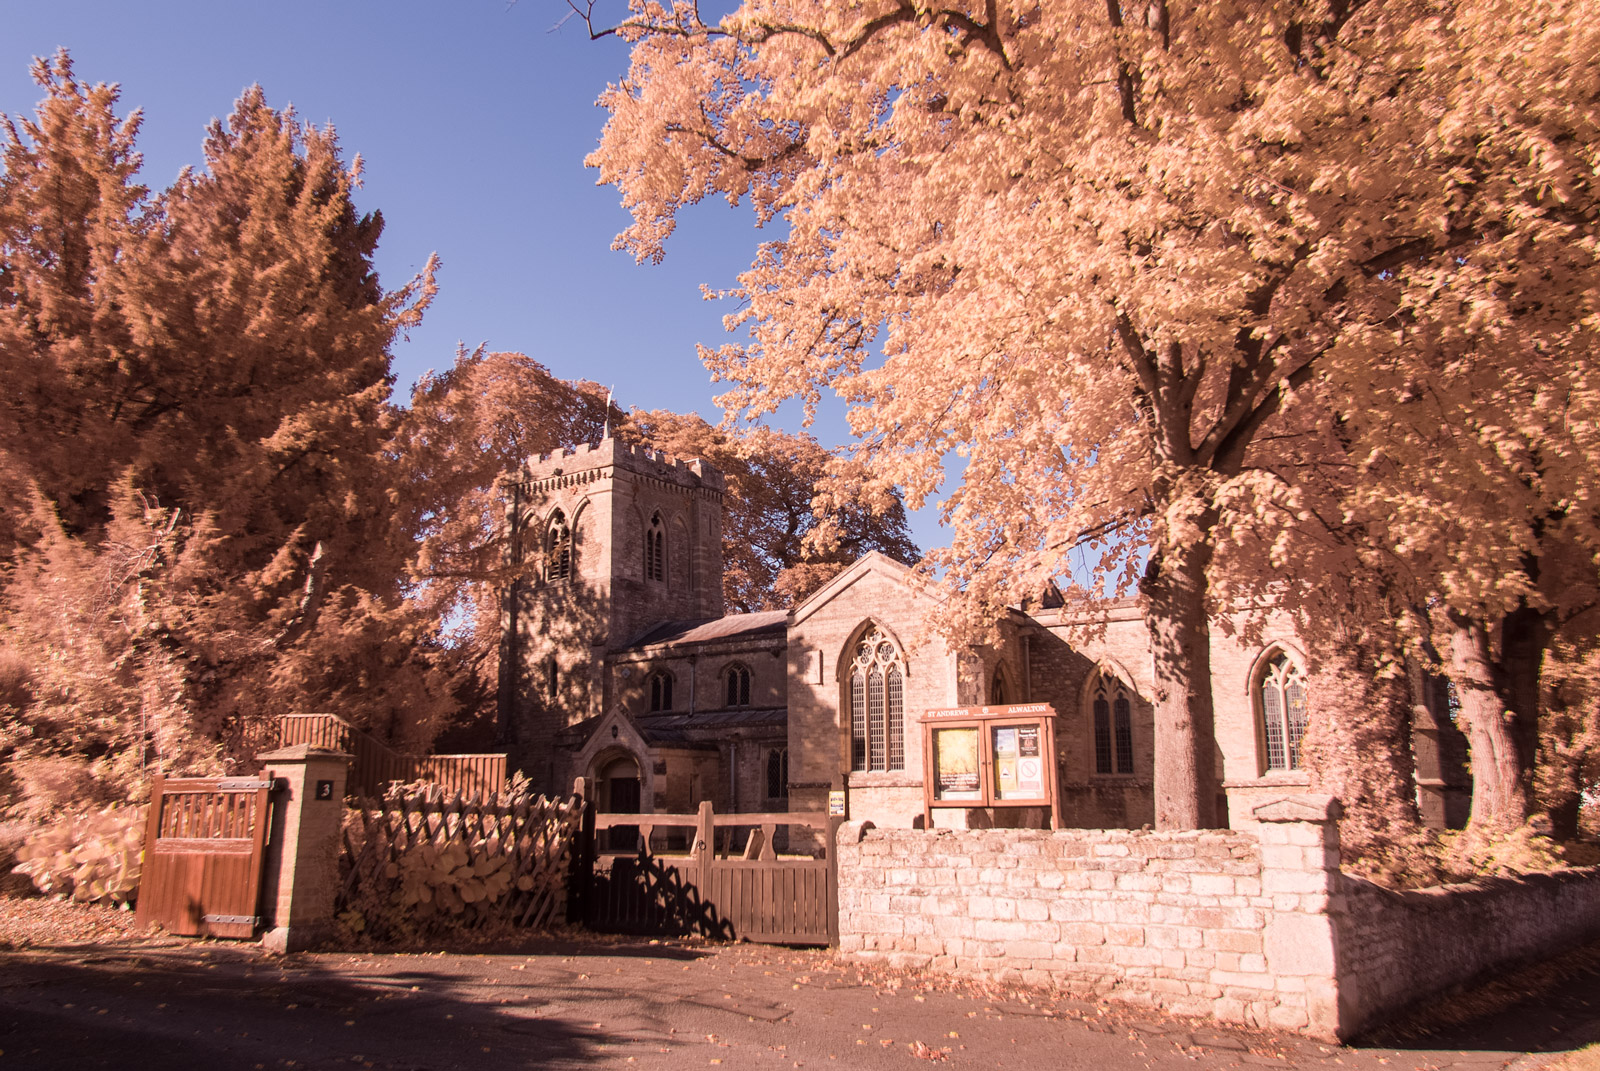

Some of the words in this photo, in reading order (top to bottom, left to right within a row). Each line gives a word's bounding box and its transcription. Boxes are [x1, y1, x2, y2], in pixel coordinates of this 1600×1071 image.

[936, 709, 969, 718] ANDREWS
[1007, 705, 1046, 713] ALWALTON
[321, 784, 330, 797] 3
